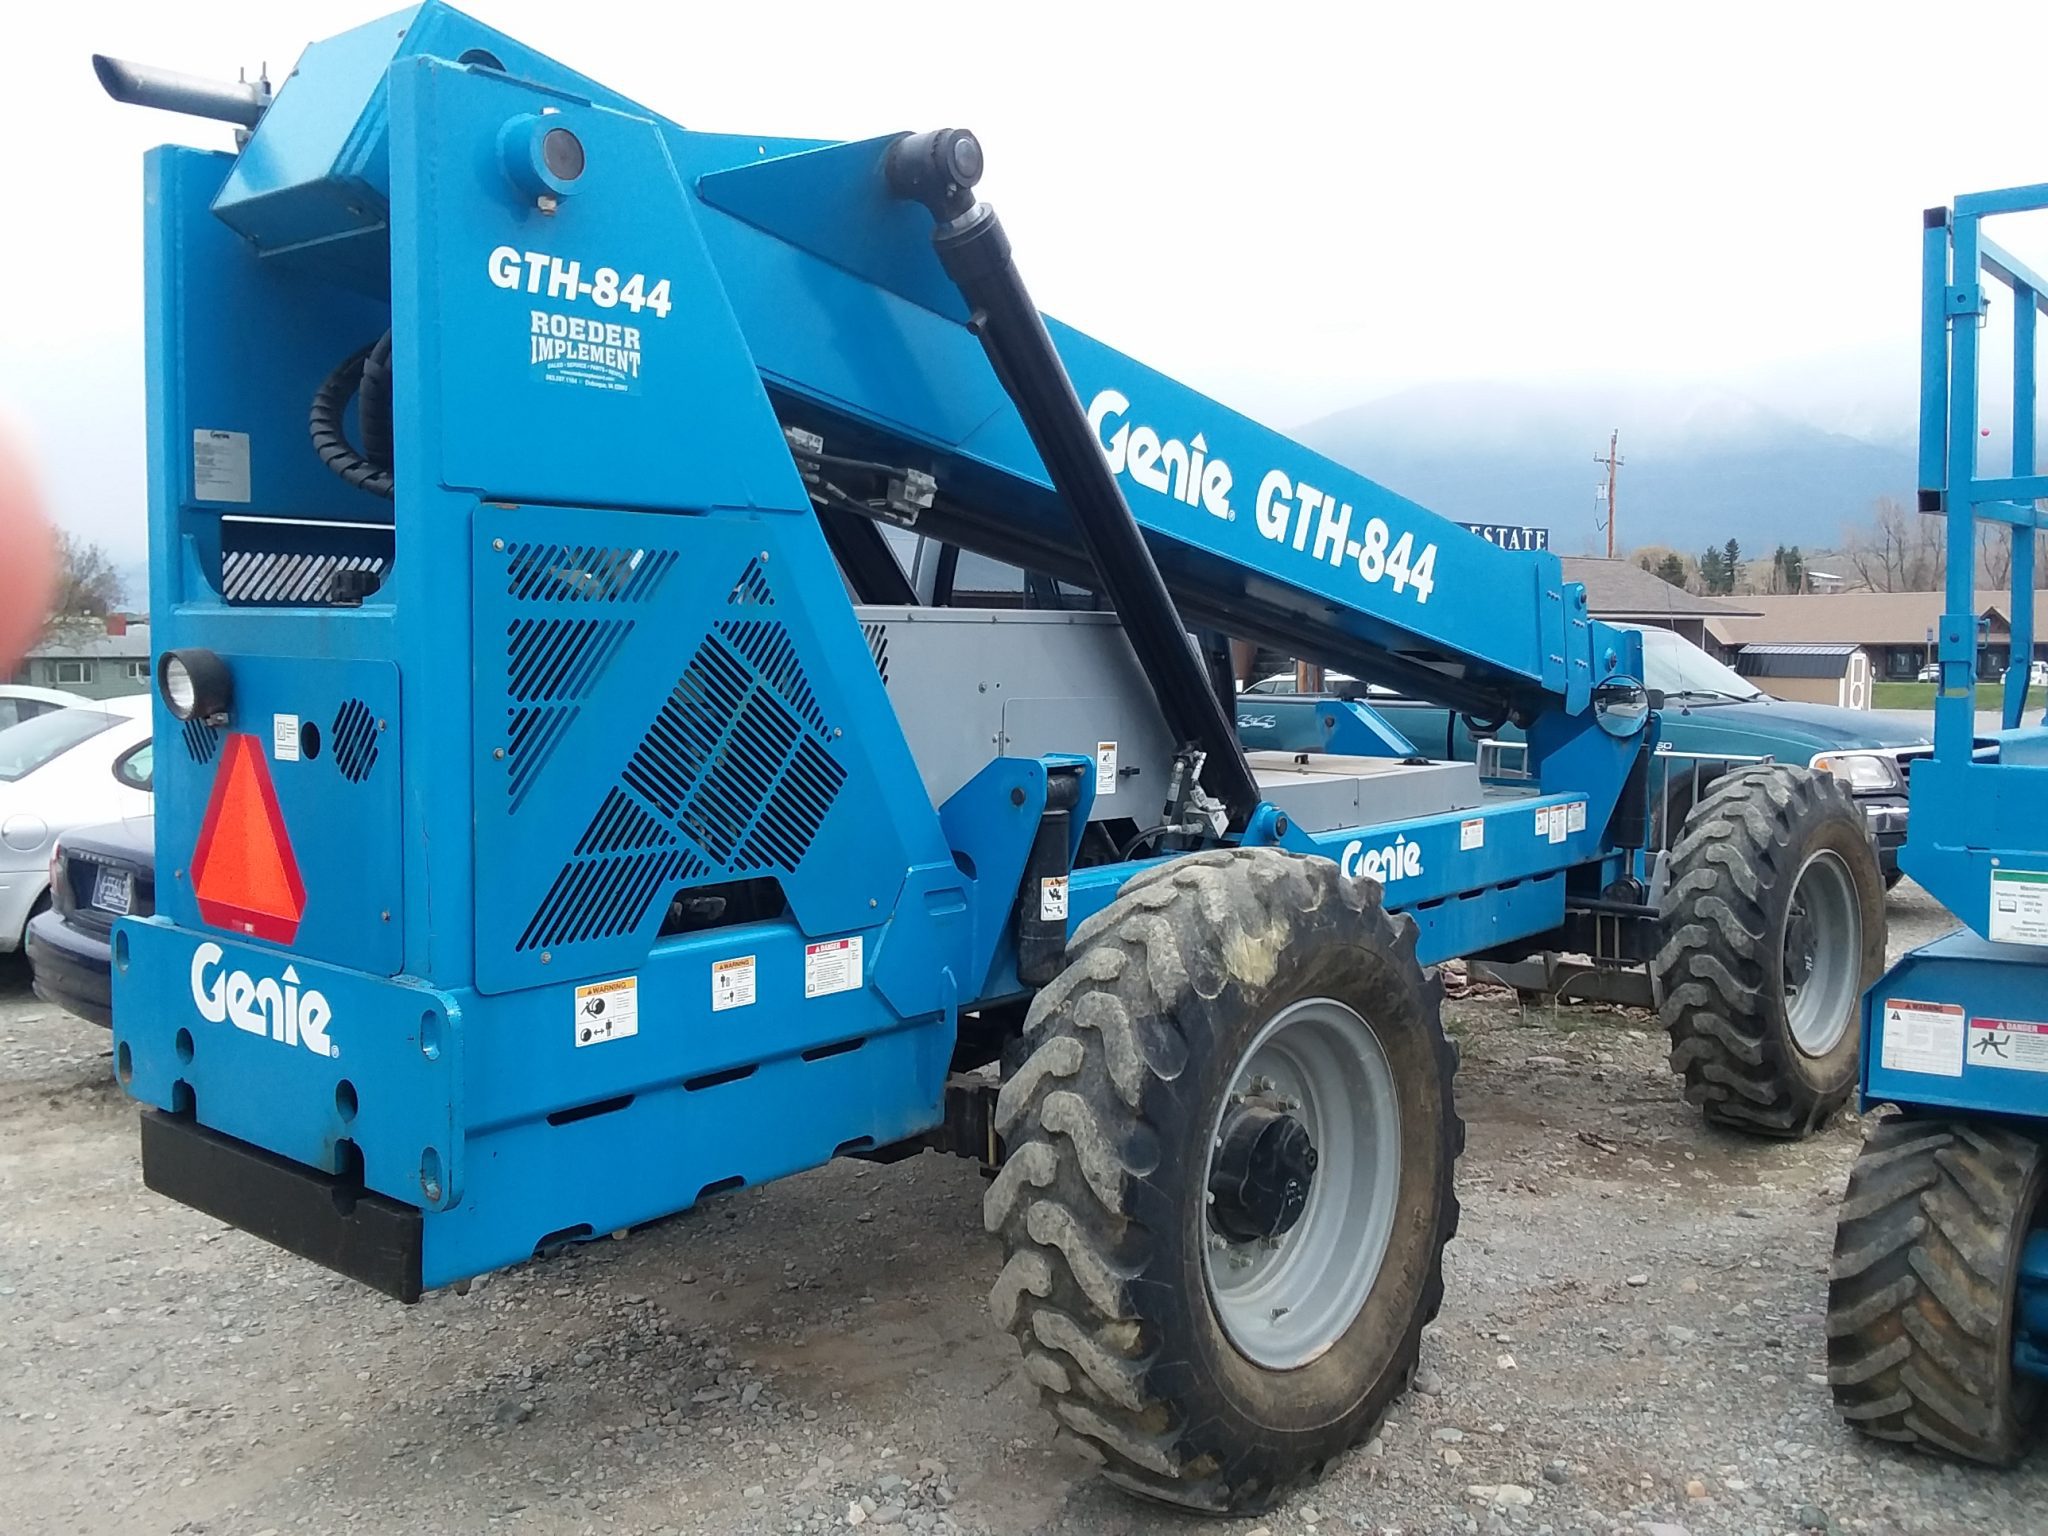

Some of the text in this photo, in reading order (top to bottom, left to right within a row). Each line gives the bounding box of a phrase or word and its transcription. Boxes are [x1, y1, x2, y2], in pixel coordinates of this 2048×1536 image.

[488, 245, 672, 319] GTH-844
[530, 310, 641, 350] ROEDER
[530, 335, 641, 379] IMPLEMENT
[1087, 388, 1438, 605] Genie GTH-844
[1340, 832, 1421, 884] Genie
[724, 959, 750, 969] WARNING
[820, 941, 841, 952] DANGER
[190, 941, 332, 1058] Genie
[592, 981, 627, 994] WARNING
[2006, 1019, 2039, 1033] DANGER
